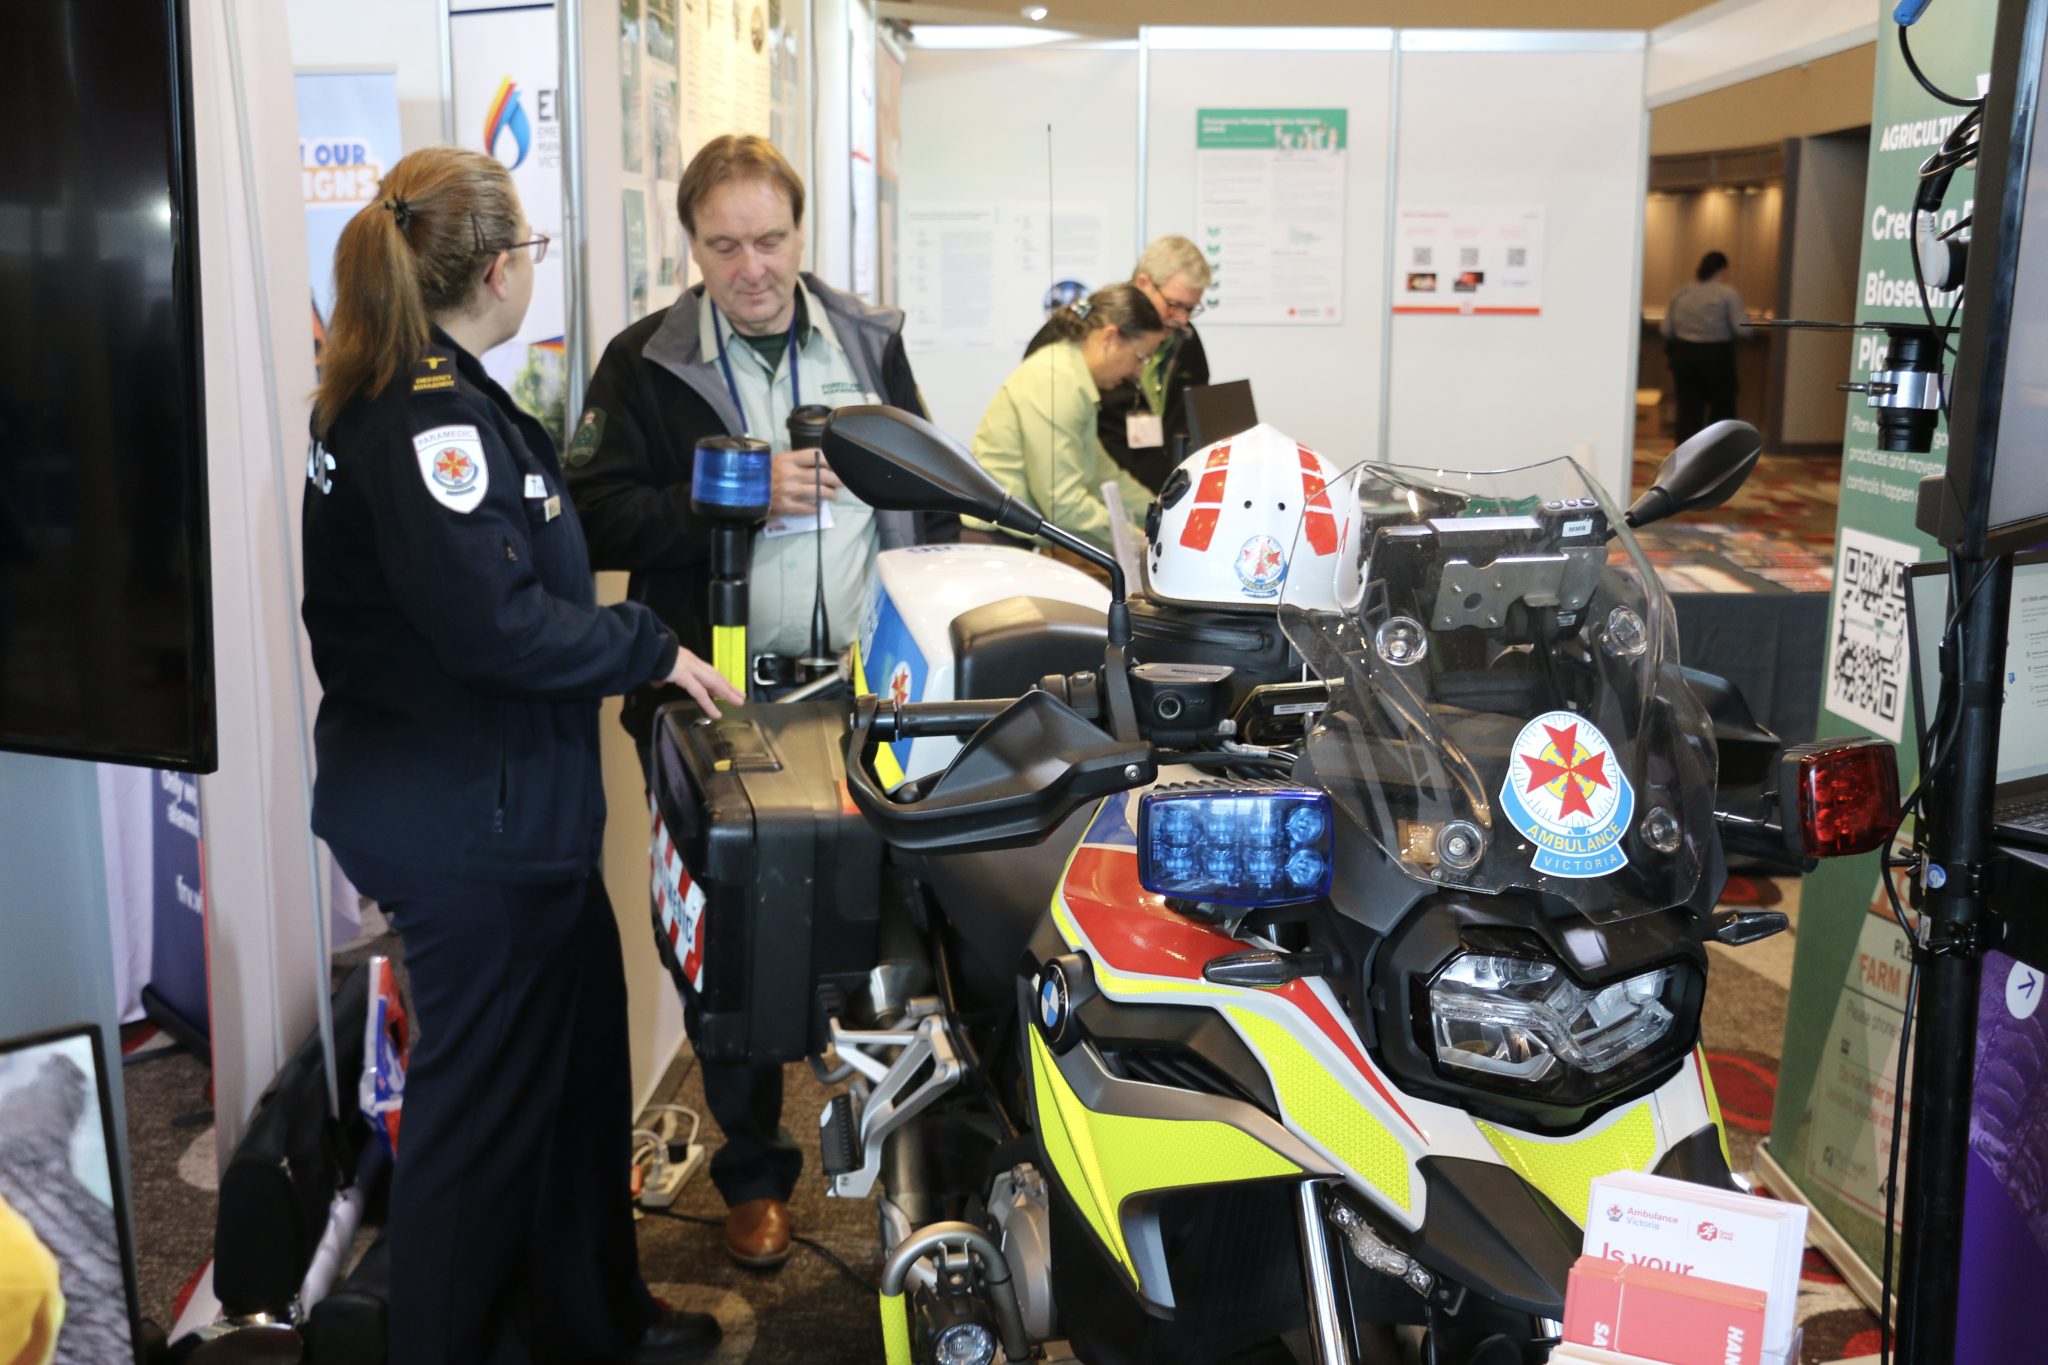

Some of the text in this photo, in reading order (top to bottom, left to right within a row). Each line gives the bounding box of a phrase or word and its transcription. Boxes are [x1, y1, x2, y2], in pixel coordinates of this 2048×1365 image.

[1880, 114, 1967, 151] AGRICULTU
[315, 143, 367, 167] OUR
[1857, 335, 1887, 372] Pla
[418, 430, 474, 447] PARAMEDIC
[1888, 453, 1906, 470] and
[1881, 481, 1914, 503] happen
[1526, 821, 1621, 853] AMBULANCE
[1544, 854, 1618, 871] VICTORIA
[1859, 953, 1902, 998] FARM
[1626, 1216, 1660, 1230] Victoria
[1627, 1207, 1678, 1224] Ambulance
[1592, 1321, 1611, 1346] SA
